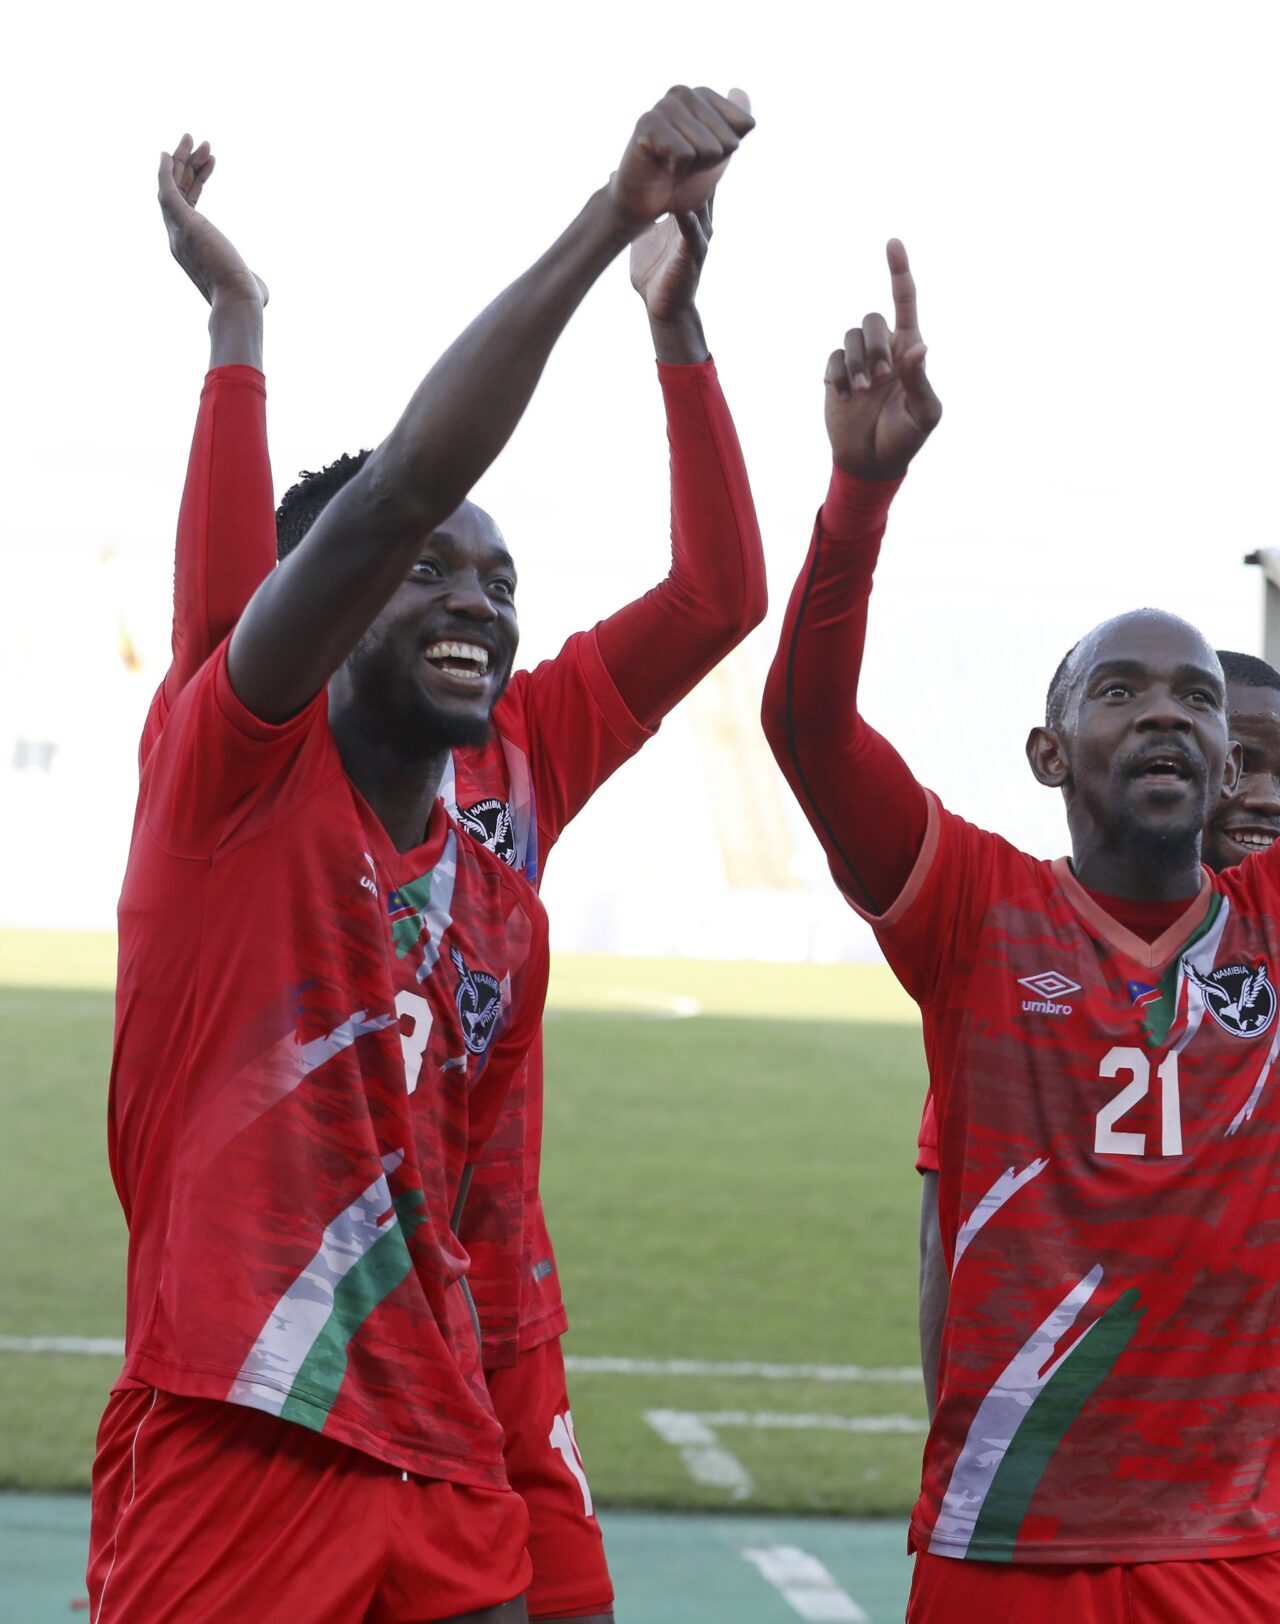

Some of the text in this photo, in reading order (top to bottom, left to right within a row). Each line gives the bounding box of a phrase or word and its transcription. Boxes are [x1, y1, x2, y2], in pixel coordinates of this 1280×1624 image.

[471, 800, 502, 816] NAMIBIA
[1212, 966, 1249, 981] NAMIBIA
[1022, 1000, 1073, 1016] umbro
[1094, 1046, 1184, 1157] 21
